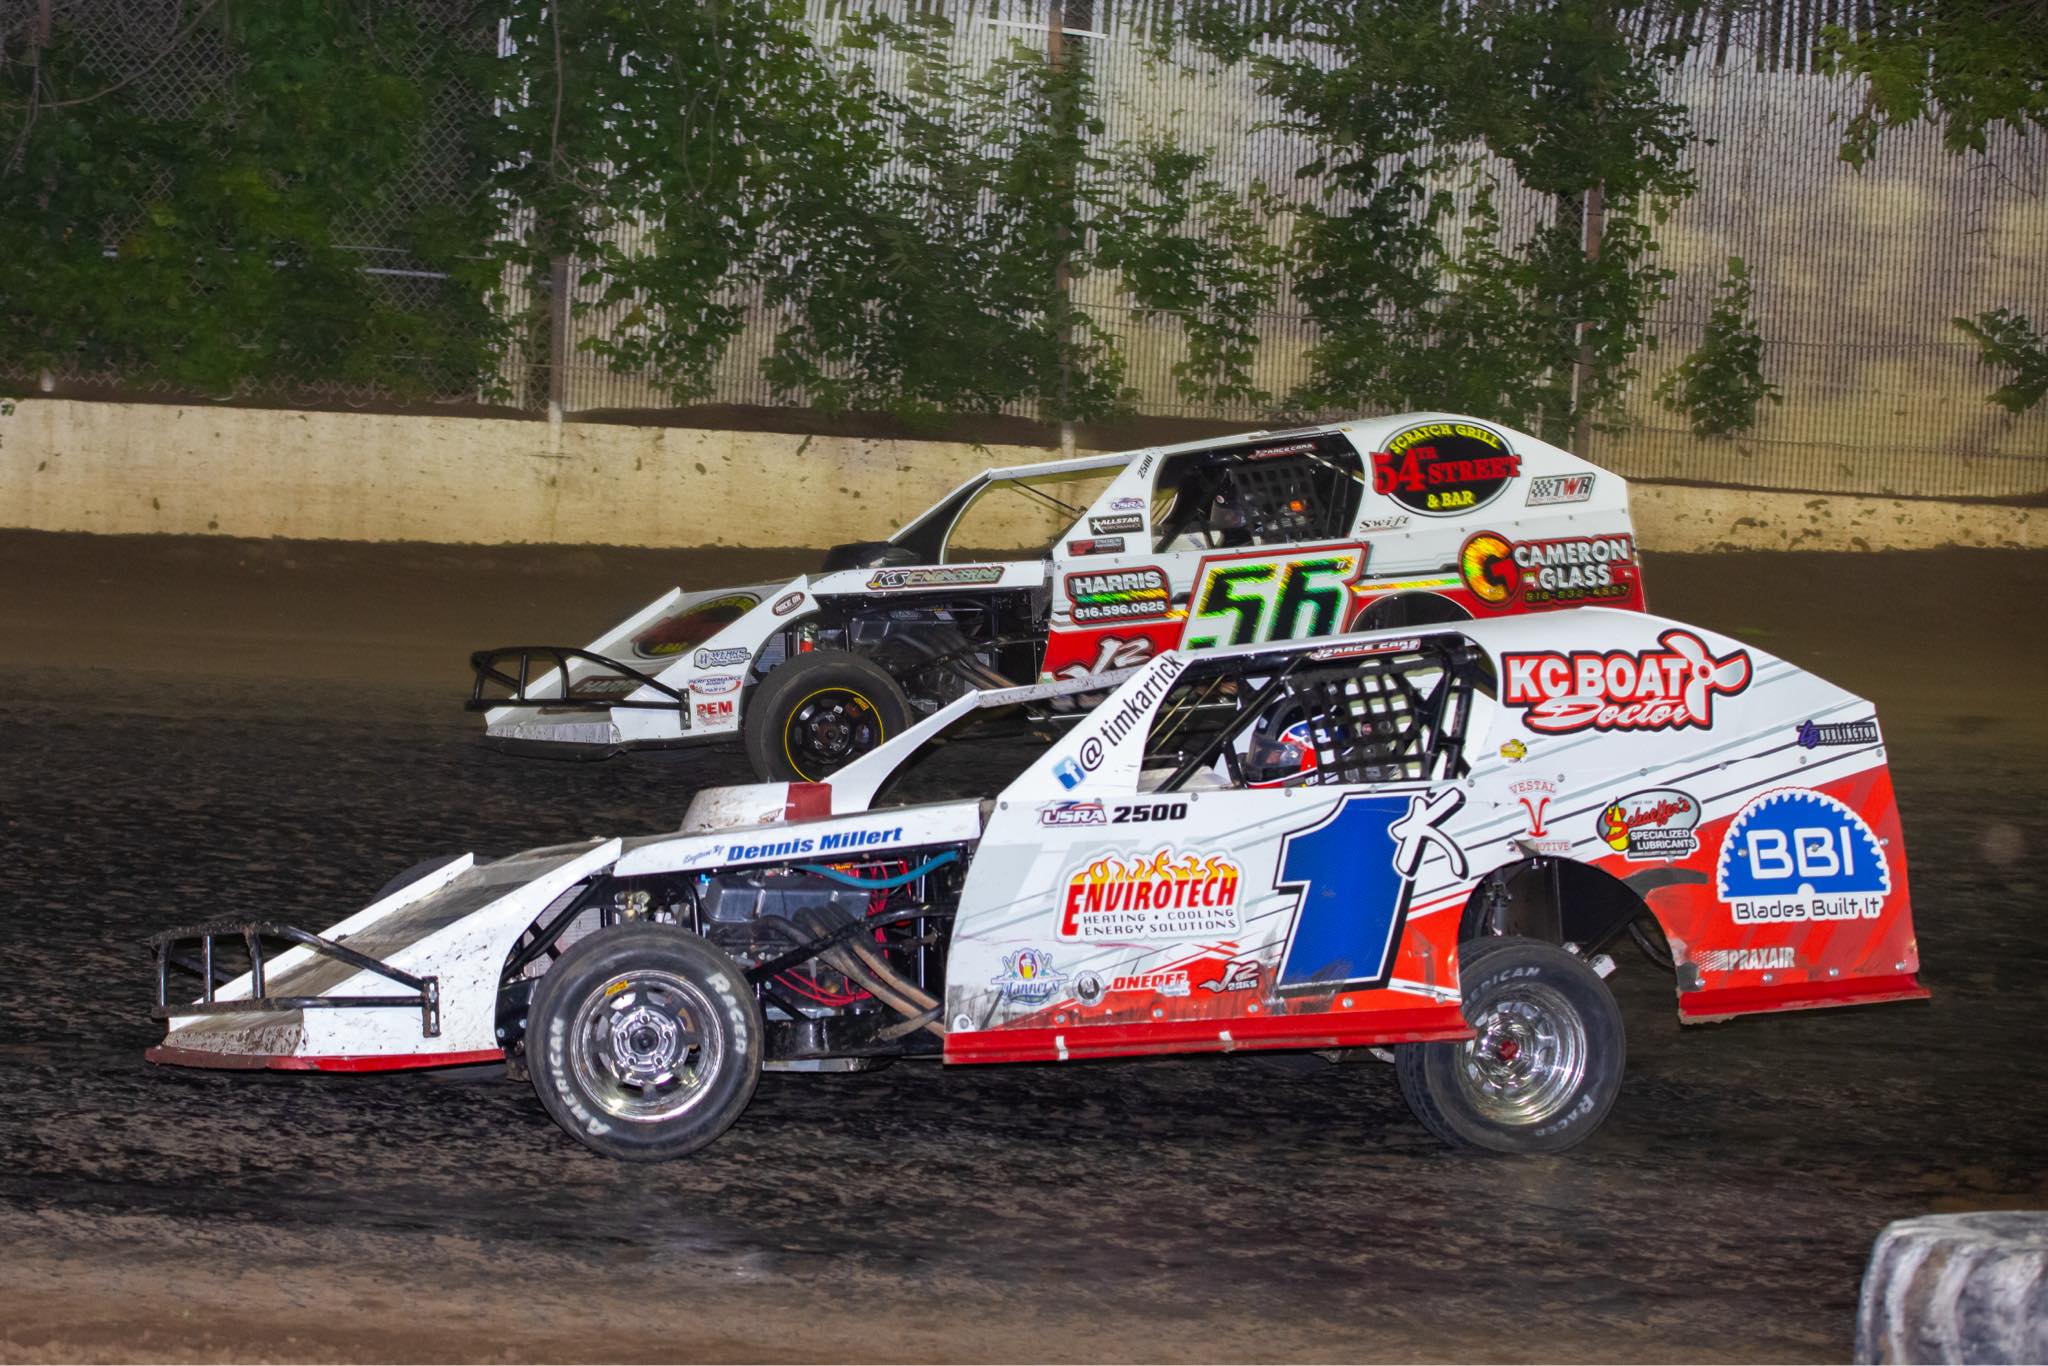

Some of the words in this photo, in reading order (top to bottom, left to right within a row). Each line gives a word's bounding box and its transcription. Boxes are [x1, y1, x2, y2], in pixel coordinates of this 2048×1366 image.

[1390, 424, 1452, 454] SCRATCH
[1455, 424, 1500, 449] GRILL
[1138, 454, 1153, 479] 2500
[1428, 454, 1521, 485] STREET
[1427, 493, 1440, 509] &
[1441, 490, 1475, 507] BAR
[1101, 516, 1140, 525] ALLSTAR
[1360, 515, 1409, 531] Swift
[1514, 539, 1629, 567] CAMERON
[1075, 571, 1162, 594] HARRIS
[1539, 564, 1611, 590] GLASS
[1075, 601, 1165, 619] 816.596.0625
[1509, 658, 1571, 698] KC
[1576, 657, 1688, 699] BOAT
[696, 701, 733, 715] PEM
[1527, 695, 1690, 729] Doctor
[1819, 727, 1876, 740] BURLINGTON
[1510, 781, 1557, 793] VESTAL
[1042, 808, 1107, 825] USRA
[1112, 803, 1188, 824] 2500
[727, 839, 815, 862] Dennis
[819, 827, 903, 851] Millert
[1630, 830, 1690, 840] SPECIALIZED
[1637, 840, 1696, 850] LUBRICANTS
[1746, 826, 1854, 880] BBI
[1061, 877, 1239, 937] ENVIROTECH
[1083, 914, 1146, 925] HEATING
[1167, 909, 1234, 921] COOLING
[1736, 901, 1806, 919] Blades
[1812, 898, 1858, 917] Built
[1864, 897, 1880, 914] It
[1084, 924, 1145, 937] ENERGY
[1150, 919, 1237, 933] SOLUTIONS
[1728, 947, 1796, 971] PRAXAIR
[706, 972, 748, 1055] RACER
[549, 1016, 612, 1136] AMERICAN
